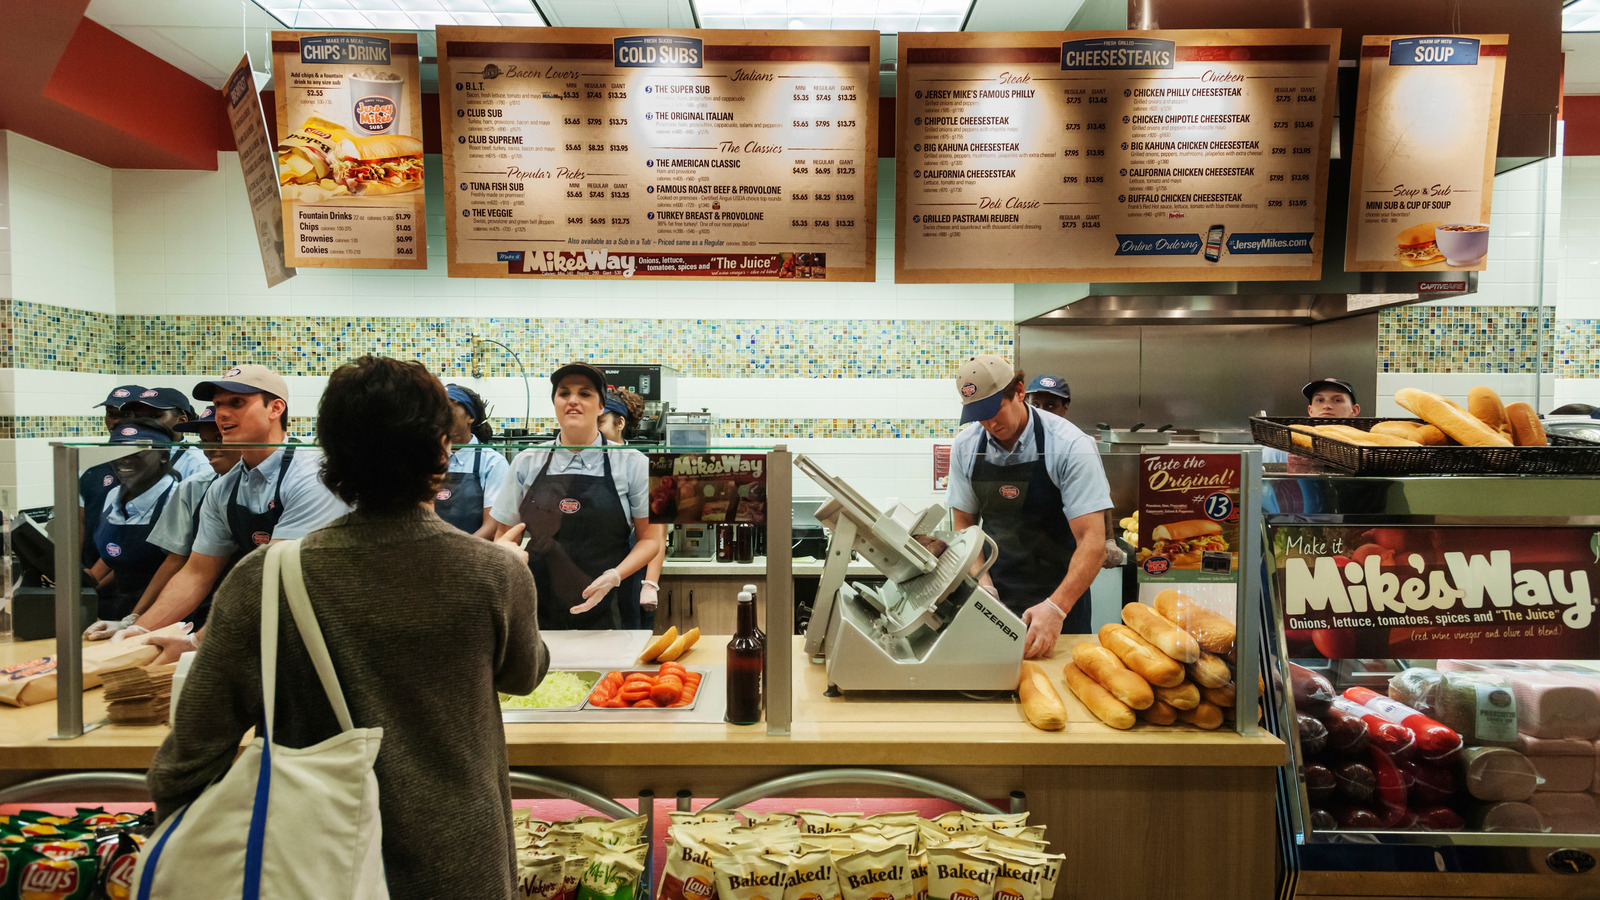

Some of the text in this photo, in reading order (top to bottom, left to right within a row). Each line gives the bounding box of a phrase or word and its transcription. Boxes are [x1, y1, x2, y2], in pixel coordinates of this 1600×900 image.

[303, 45, 340, 60] CHIPS
[349, 45, 387, 61] DRINK
[619, 46, 698, 64] COLD SUBS
[1415, 46, 1454, 62] SOUP
[506, 65, 579, 79] Bacon Lovers
[731, 68, 774, 81] Italians
[1201, 70, 1245, 82] Chicken
[999, 72, 1030, 85] Steak
[466, 82, 485, 90] B.L.T.
[655, 85, 669, 93] THE
[670, 85, 694, 93] SUPER
[925, 90, 1035, 99] JERSEY MIKE'S FAMOUS PHILLY
[1134, 88, 1242, 97] CHICKEN PHILLY CHEESESTEAK
[357, 102, 393, 117] Jersey
[467, 109, 502, 118] CLUB SUB
[360, 113, 392, 124] Mike's
[656, 112, 669, 120] THE
[671, 112, 704, 120] ORIGINAL
[924, 117, 1009, 125] CHIPOTLE CHEESESTEAK
[1132, 114, 1250, 124] CHICKEN CHIPOTLE CHEESESTEAK
[468, 136, 523, 144] CLUB SUPREME
[1131, 141, 1259, 150] BIG KAHUNA CHICKEN CHEESESTEAK
[719, 141, 782, 153] The Classics
[938, 143, 968, 151] KAHUNA
[970, 143, 1020, 151] CHEESESTEAK
[656, 159, 740, 168] THE AMERICAN CLASSIC
[507, 166, 586, 181] Popular Picks
[924, 170, 1016, 178] CALIFORNIA CHEESESTEAK
[1130, 168, 1254, 176] CALIFORNIA CHICKEN CHEESESTEAK
[470, 182, 524, 191] TUNA FISH SUB
[657, 185, 781, 194] FAMOUS ROAST BEEF & PROVOLONE
[1393, 184, 1419, 198] Soup
[1431, 184, 1451, 196] Sub
[979, 197, 1041, 209] Deli Classic
[1128, 194, 1242, 202] BUFFALO CHICKEN CHEESESTEAK
[1366, 201, 1382, 209] MINI
[1384, 201, 1398, 209] SUB
[1407, 201, 1421, 209] CUP
[1422, 201, 1431, 209] OF
[1432, 201, 1451, 209] SOUP
[299, 211, 352, 220] Fountain Drinks
[472, 209, 513, 218] THE VEGGIE
[657, 212, 763, 220] TURKEY BREAST & PROVOLONE
[923, 215, 950, 223] GRILLED
[953, 215, 989, 223] PASTRAMI
[300, 222, 319, 231] Chips
[301, 234, 333, 242] Brownies
[301, 246, 328, 254] Cookies
[1121, 238, 1199, 253] Online Ordering
[1233, 239, 1307, 250] JerseyMikes.com
[523, 248, 637, 278] Mike's Way
[678, 263, 697, 271] spices
[673, 455, 762, 478] Mike's Way
[1144, 456, 1206, 471] Taste the
[1149, 469, 1234, 493] Original!
[1208, 496, 1229, 517] 13
[1286, 536, 1343, 555] Make it
[1286, 550, 1595, 629] Mike's Way
[974, 601, 1018, 641] BIZERBA
[1289, 609, 1560, 630] Onions, lettuce, tomatoes, spices and "The Juice"
[1411, 630, 1429, 642] (red
[1432, 632, 1450, 640] wine
[1454, 631, 1482, 644] vinegar
[1485, 629, 1499, 639] and
[1503, 628, 1522, 638] olive
[1525, 627, 1534, 637] oil
[23, 864, 75, 892] Lay's
[848, 866, 904, 890] Baked!
[937, 863, 994, 885] Baked!
[729, 873, 786, 890] Baked!
